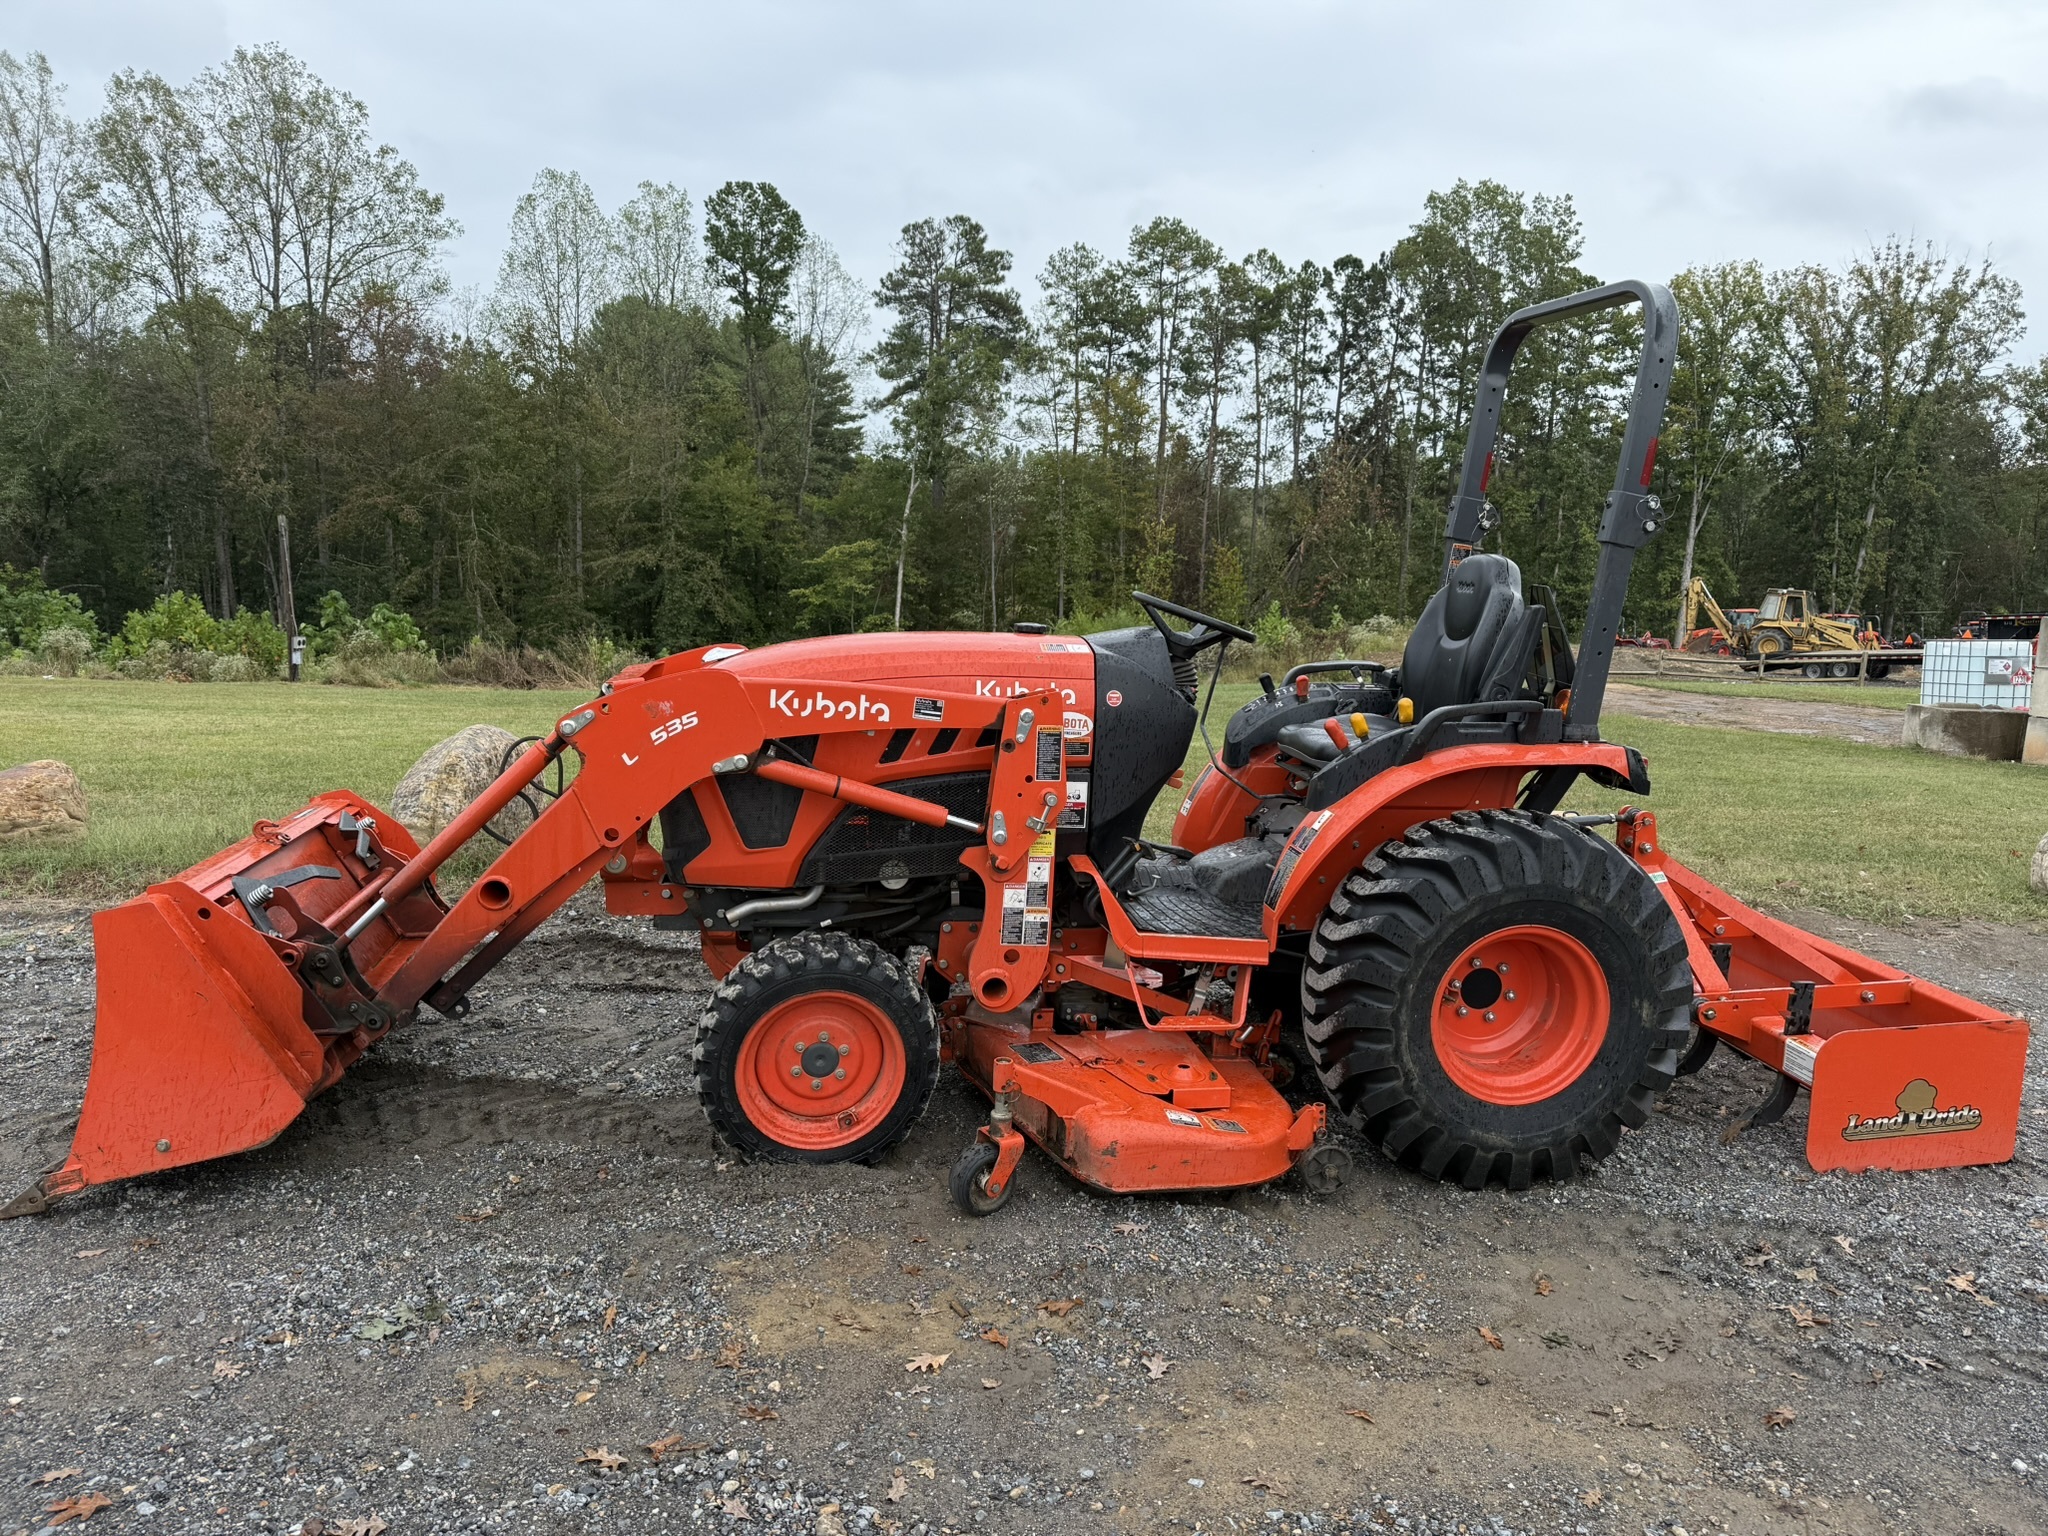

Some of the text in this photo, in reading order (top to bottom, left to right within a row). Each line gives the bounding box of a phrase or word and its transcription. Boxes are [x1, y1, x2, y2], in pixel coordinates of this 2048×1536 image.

[769, 688, 890, 722] Kubota
[975, 680, 1076, 705] Kuba
[621, 711, 699, 766] L 535
[1064, 717, 1090, 732] BOTA
[1845, 1105, 1980, 1134] Land Pride
